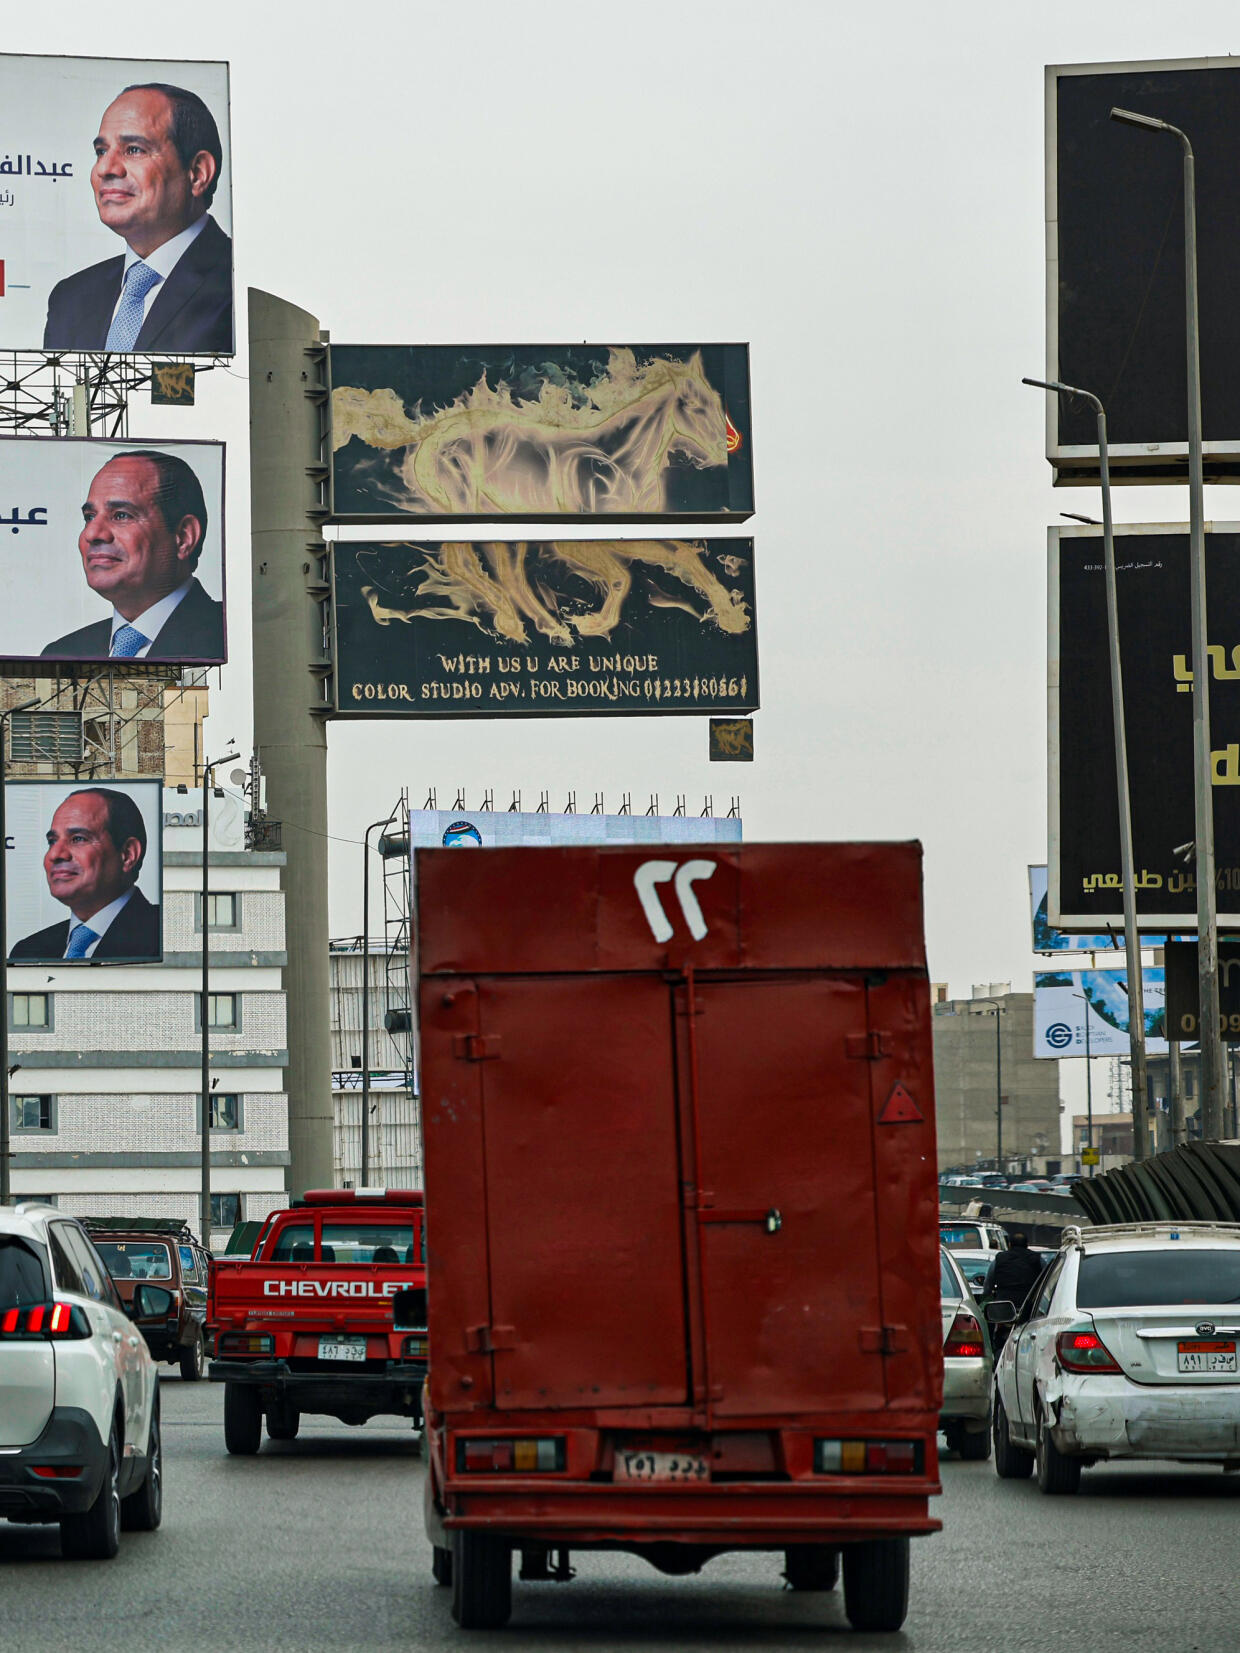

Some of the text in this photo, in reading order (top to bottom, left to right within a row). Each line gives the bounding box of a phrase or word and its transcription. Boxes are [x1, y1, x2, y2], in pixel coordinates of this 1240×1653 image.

[437, 652, 658, 677] WITH US U ARE UNIQUE
[352, 682, 415, 702] COLOR
[421, 680, 482, 699] STUDIO
[489, 682, 526, 700] ADV.
[531, 679, 568, 700] FOR
[567, 676, 640, 700] BOOKING
[263, 1280, 414, 1297] CHEVROLET
